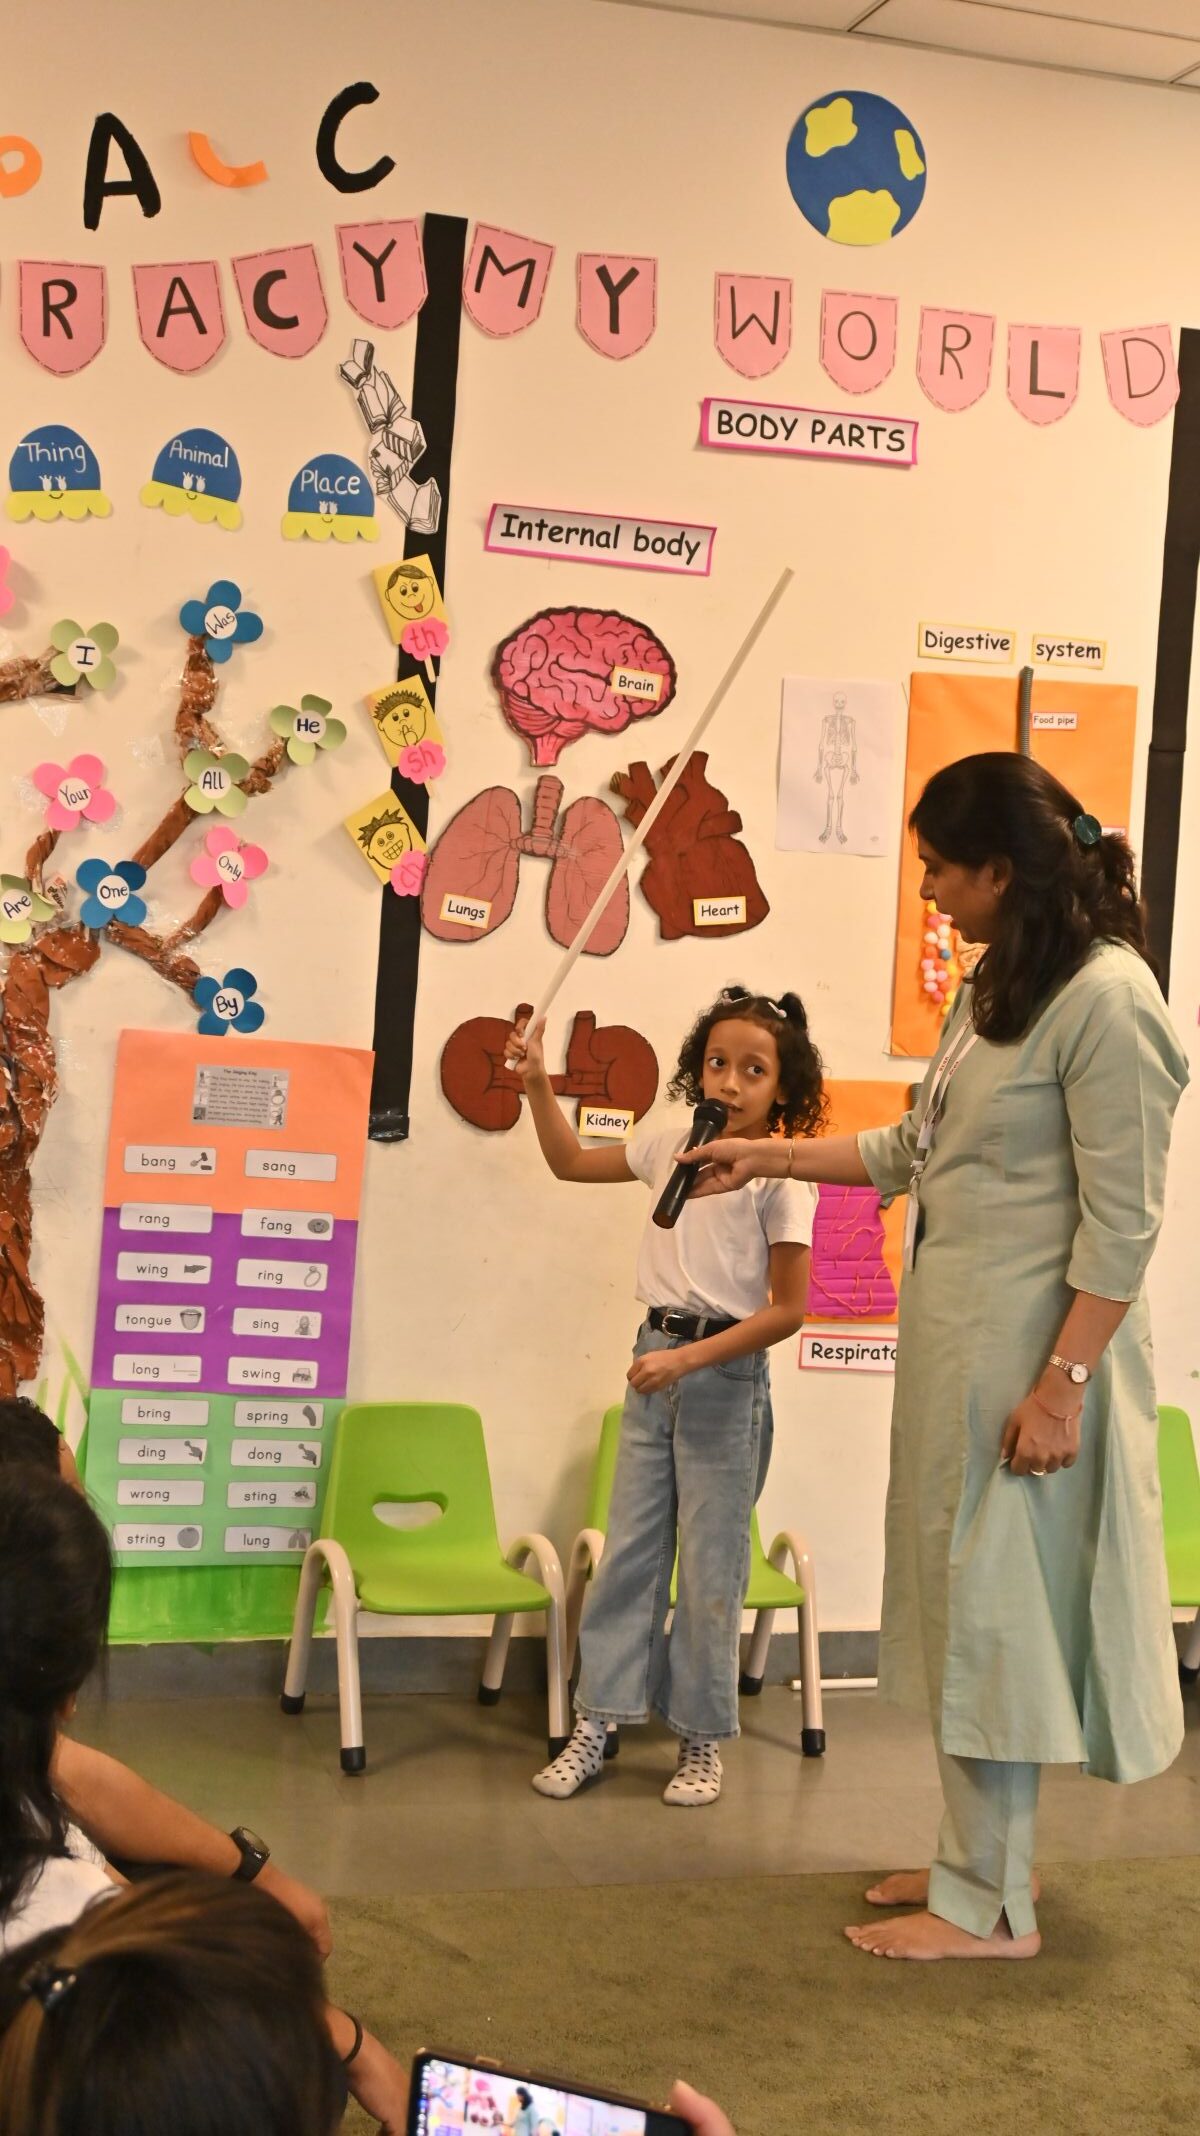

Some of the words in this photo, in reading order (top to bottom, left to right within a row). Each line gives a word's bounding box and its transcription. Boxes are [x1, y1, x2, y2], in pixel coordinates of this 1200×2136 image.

[730, 286, 1166, 399] WORLD
[717, 411, 798, 443] BODY
[812, 421, 905, 452] PARTS
[19, 443, 87, 472] Thing
[169, 440, 229, 468] Animal
[300, 470, 361, 495] Place
[500, 513, 620, 551] Internal
[635, 522, 701, 564] body
[206, 611, 235, 637] Was
[410, 626, 440, 650] th
[924, 630, 1010, 654] Digestive
[1035, 640, 1101, 662] system
[76, 645, 95, 665] I
[618, 675, 654, 693] Brain
[296, 716, 320, 734] He
[1033, 716, 1054, 724] Food
[1057, 717, 1075, 726] pipe
[406, 746, 438, 774] sh
[202, 771, 225, 790] All
[59, 785, 91, 806] Your
[218, 855, 242, 881] Only
[99, 884, 128, 899] One
[3, 896, 31, 919] Are
[447, 900, 485, 920] Lungs
[700, 904, 739, 917] Heart
[215, 995, 238, 1018] By
[586, 1112, 630, 1131] Kidney
[141, 1153, 176, 1169] bang
[262, 1161, 296, 1175] sang
[139, 1214, 170, 1228] rang
[260, 1216, 292, 1234] fang
[136, 1263, 168, 1278] wing
[257, 1269, 283, 1284] ring
[125, 1314, 172, 1328] tongue
[252, 1318, 279, 1333] sing
[132, 1362, 160, 1378] long
[242, 1368, 281, 1381] swing
[137, 1407, 171, 1422] bring
[246, 1409, 289, 1424] spring
[137, 1446, 166, 1461] ding
[247, 1446, 282, 1462] dong
[130, 1488, 170, 1501] wrong
[244, 1490, 277, 1504] sting
[127, 1532, 166, 1547] string
[243, 1533, 270, 1549] lung
